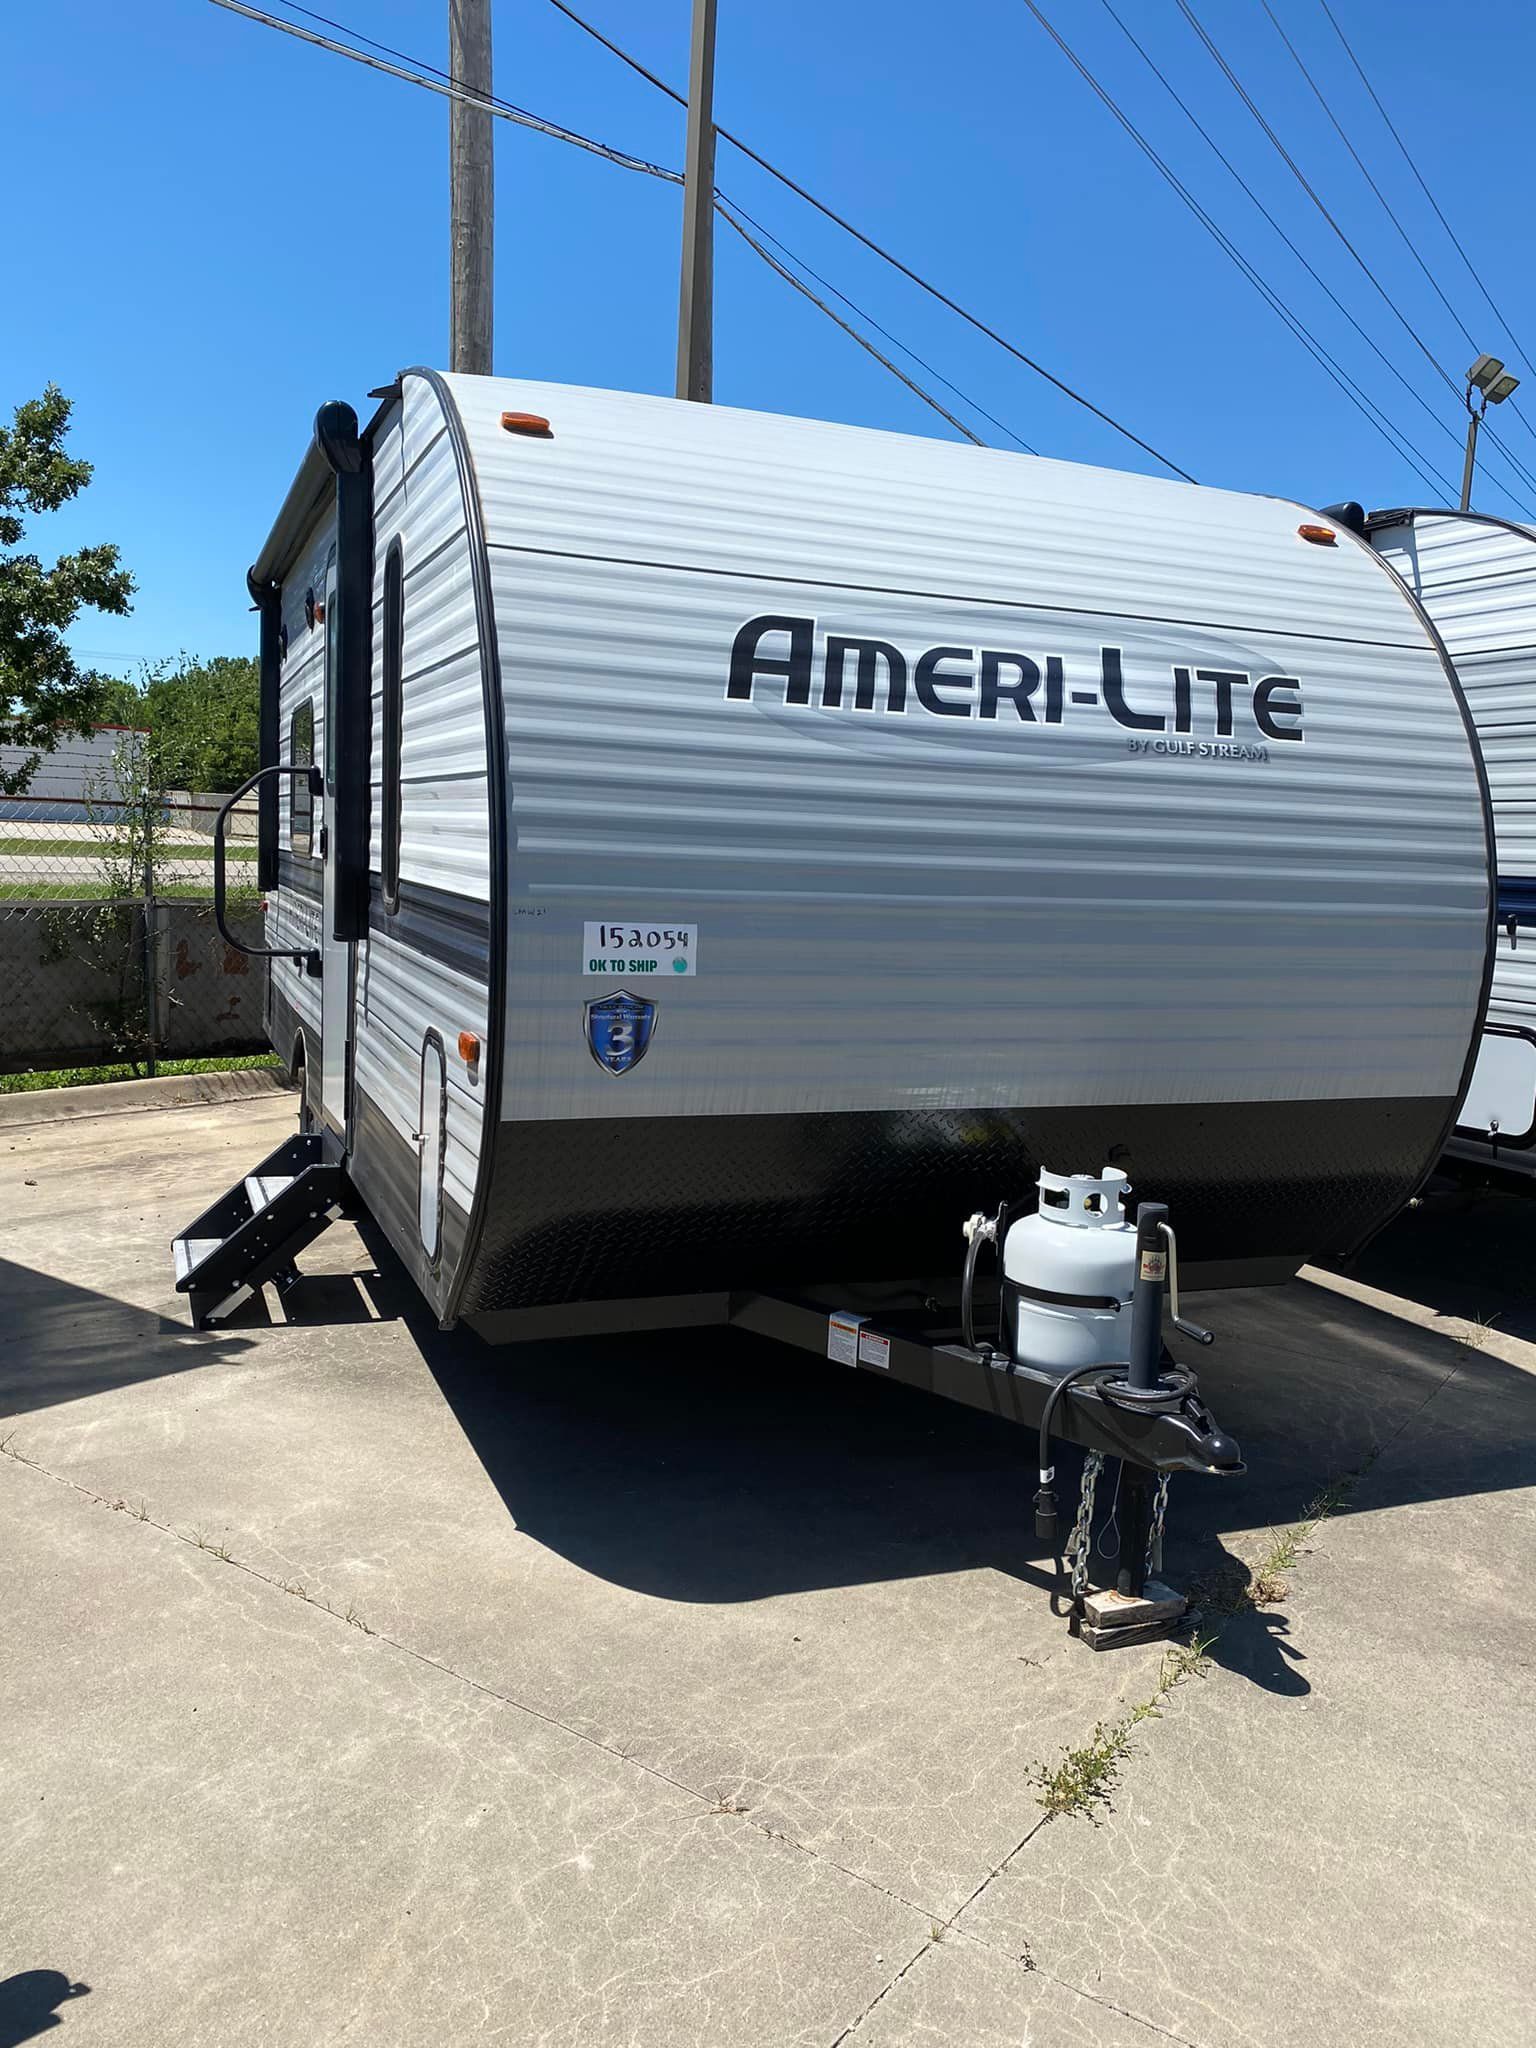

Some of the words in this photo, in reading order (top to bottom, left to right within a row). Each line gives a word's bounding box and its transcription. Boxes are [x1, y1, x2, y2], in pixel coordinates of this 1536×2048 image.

[724, 613, 1306, 743] AMERI-LITE
[1127, 737, 1149, 752] BY
[1152, 738, 1196, 756] GULF
[1199, 742, 1271, 764] STREAM
[600, 924, 689, 950] 152054
[589, 958, 607, 973] OK
[610, 959, 626, 973] TO
[629, 959, 658, 973] SHIP
[606, 1022, 634, 1056] 3
